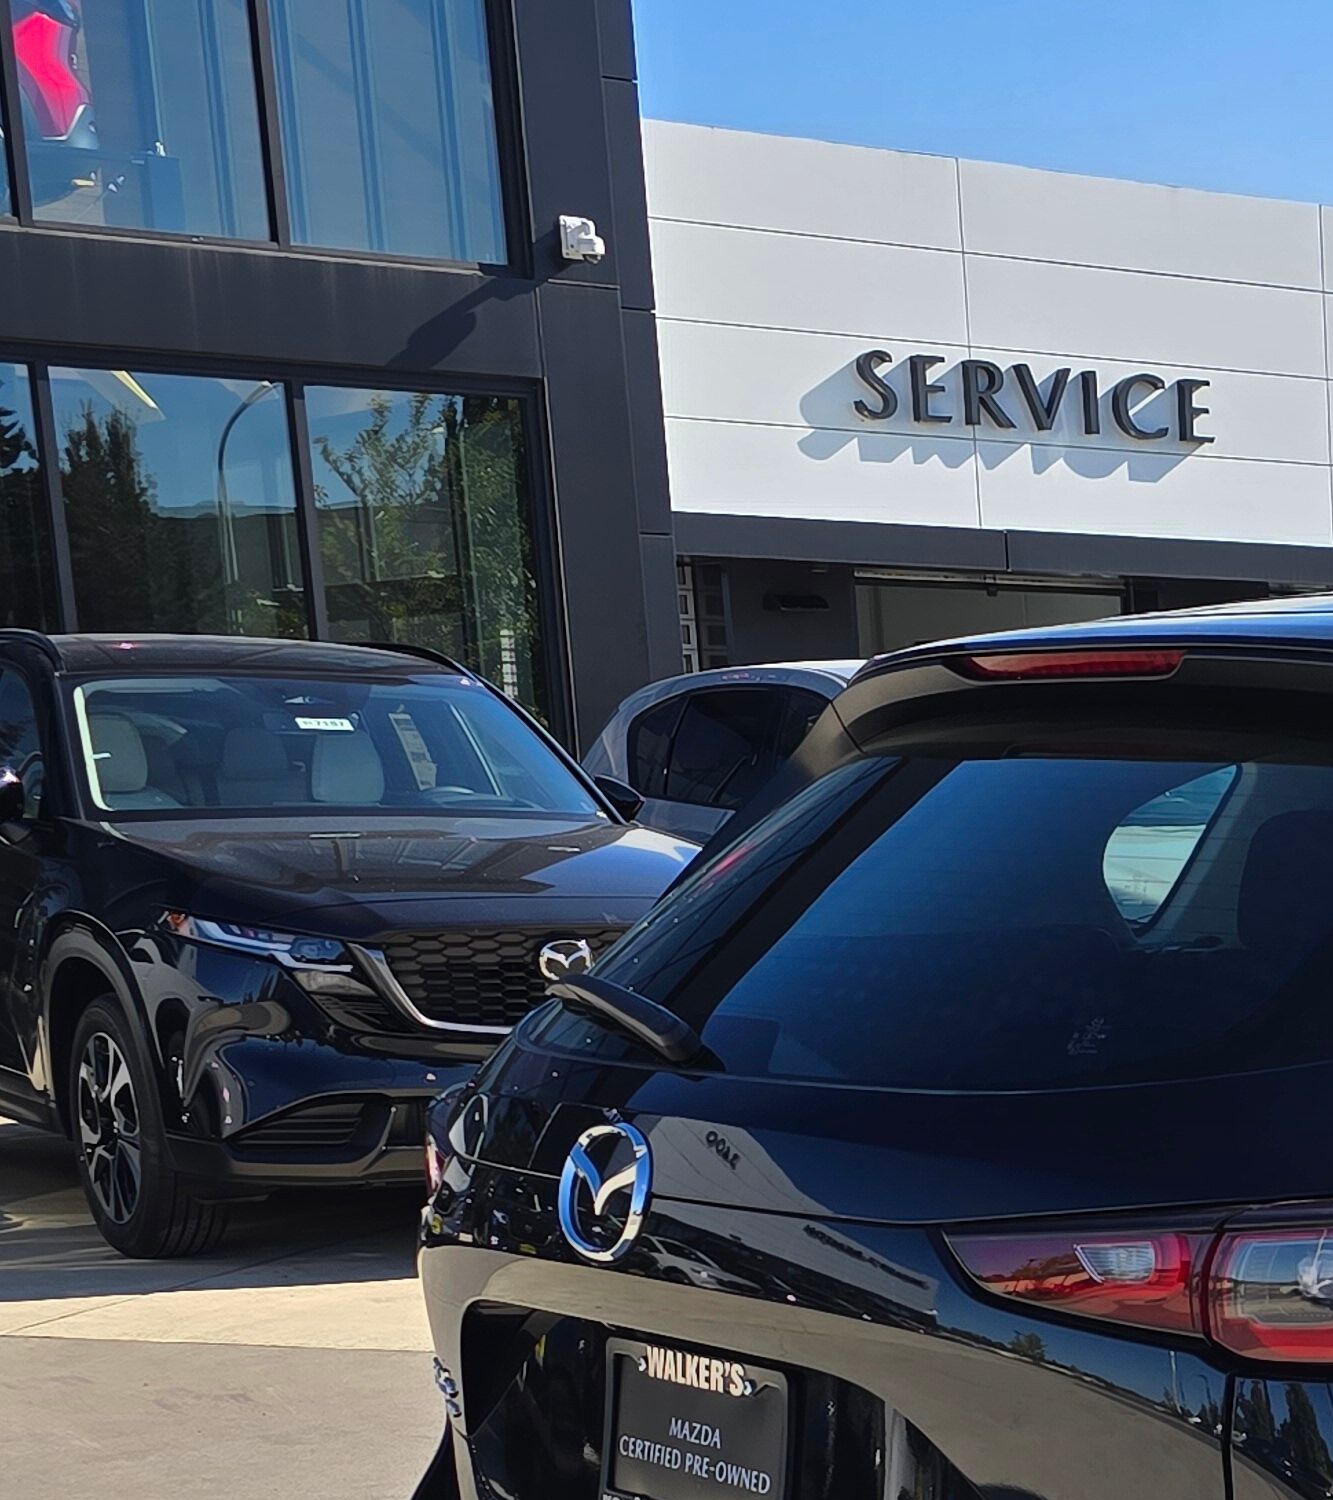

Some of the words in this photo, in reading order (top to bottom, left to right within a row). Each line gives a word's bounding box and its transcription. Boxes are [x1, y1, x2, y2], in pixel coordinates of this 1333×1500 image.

[852, 349, 1216, 444] SERVICE
[646, 1345, 746, 1397] WALKER'S
[668, 1416, 722, 1449] MAZDA
[618, 1434, 682, 1470] CERTIFIED
[684, 1455, 771, 1495] PRE-OWNED
